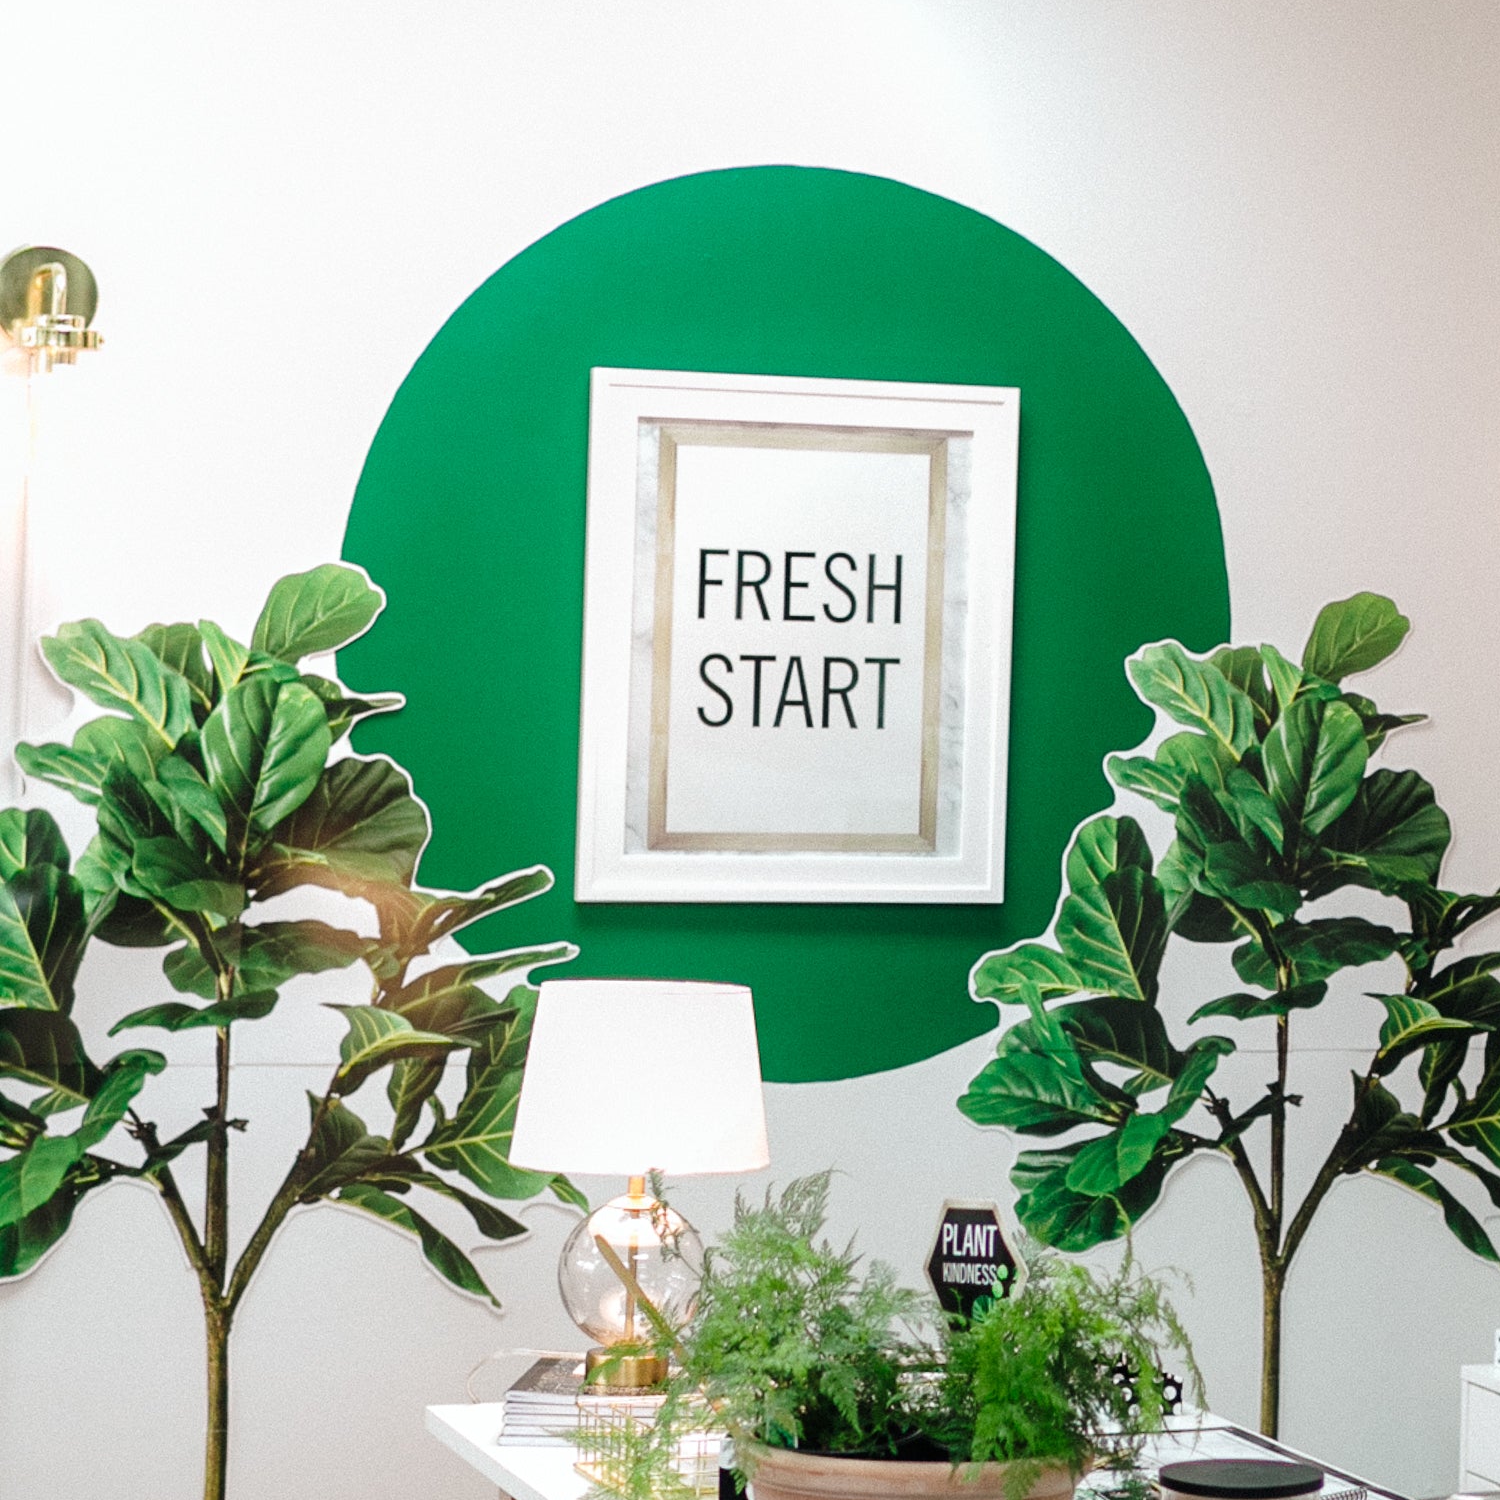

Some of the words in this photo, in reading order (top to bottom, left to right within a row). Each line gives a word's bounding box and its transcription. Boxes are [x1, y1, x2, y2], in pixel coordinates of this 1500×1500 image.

[697, 548, 903, 624] FRESH
[697, 653, 901, 729] START
[943, 1223, 998, 1258] PLANT
[943, 1262, 998, 1286] KINDNESS
